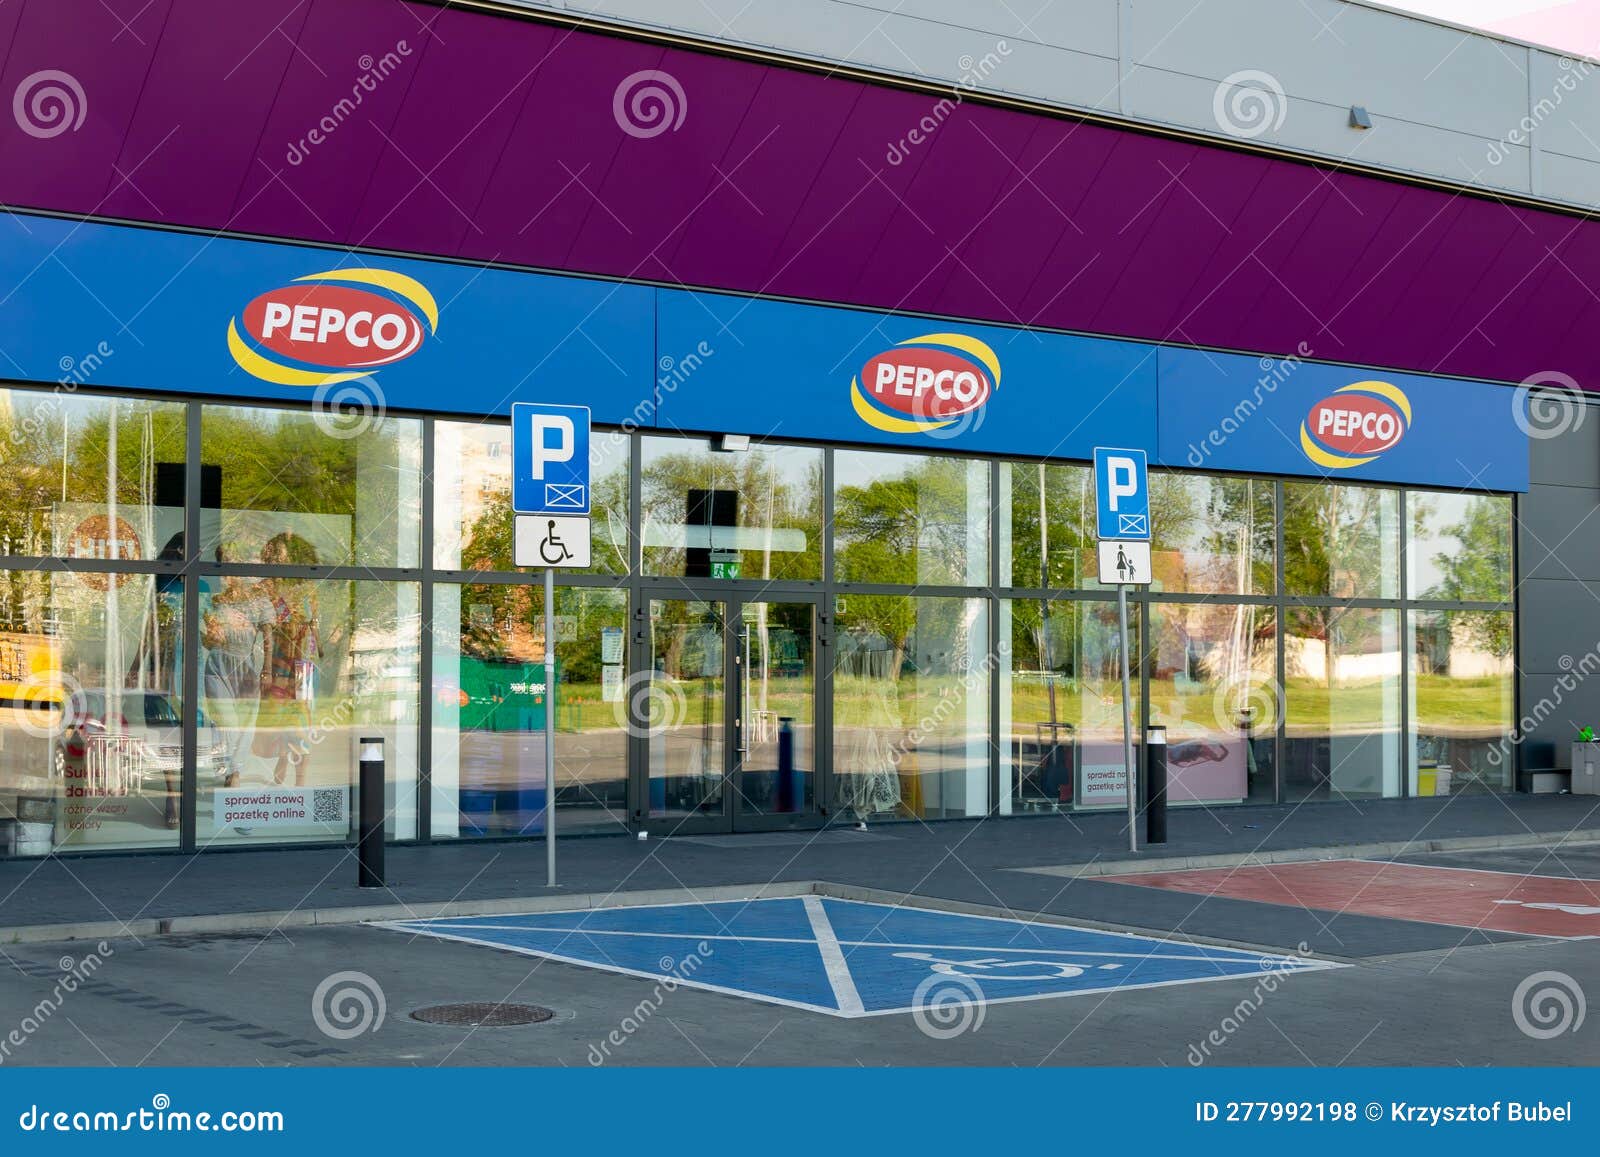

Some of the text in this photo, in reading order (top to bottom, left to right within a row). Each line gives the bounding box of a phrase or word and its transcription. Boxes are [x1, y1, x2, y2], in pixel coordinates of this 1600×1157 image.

[263, 303, 407, 350] PEPCO
[876, 363, 979, 402] PEPCO
[1319, 408, 1395, 441] PEPCO
[532, 414, 574, 480] P
[1108, 457, 1136, 511] P
[224, 794, 304, 807] sprawdź nową
[224, 808, 305, 823] gazetkę online
